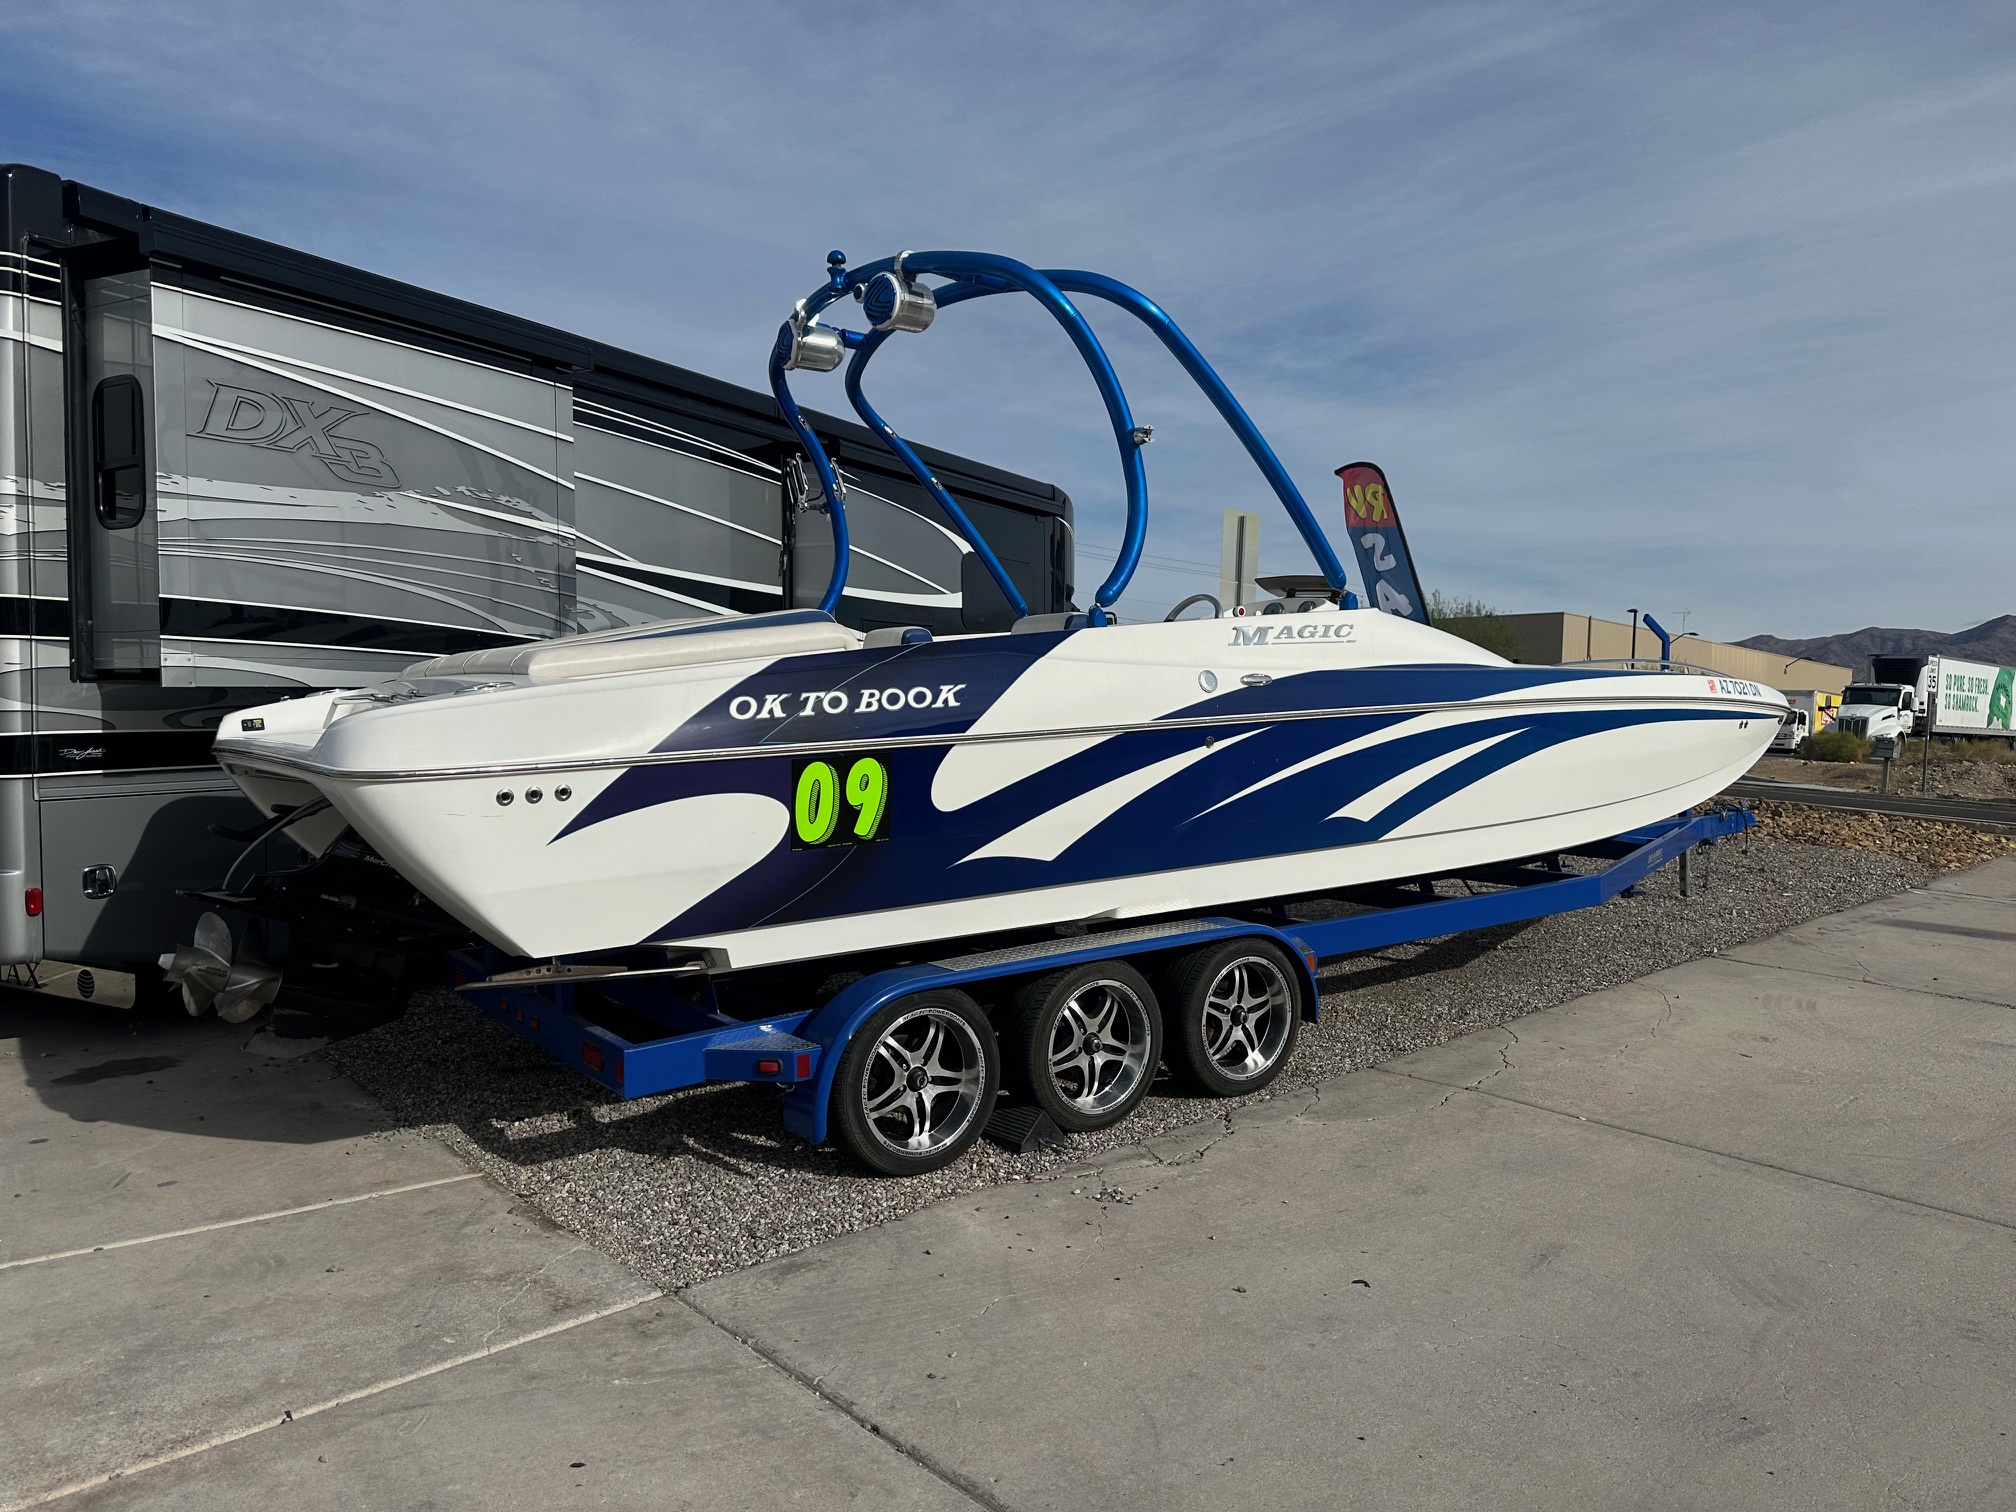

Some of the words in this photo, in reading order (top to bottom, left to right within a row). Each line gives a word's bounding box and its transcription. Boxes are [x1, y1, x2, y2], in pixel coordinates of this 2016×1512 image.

[186, 379, 401, 488] DX3
[1228, 624, 1354, 646] MAGIC
[1719, 679, 1731, 694] AZ
[1928, 675, 1936, 689] 35
[1946, 673, 1952, 690] SO
[1968, 676, 1974, 693] SO
[729, 692, 792, 721] OK
[799, 690, 848, 717] TO
[854, 684, 967, 714] BOOK
[1945, 693, 1951, 710] SO
[795, 757, 888, 845] 09
